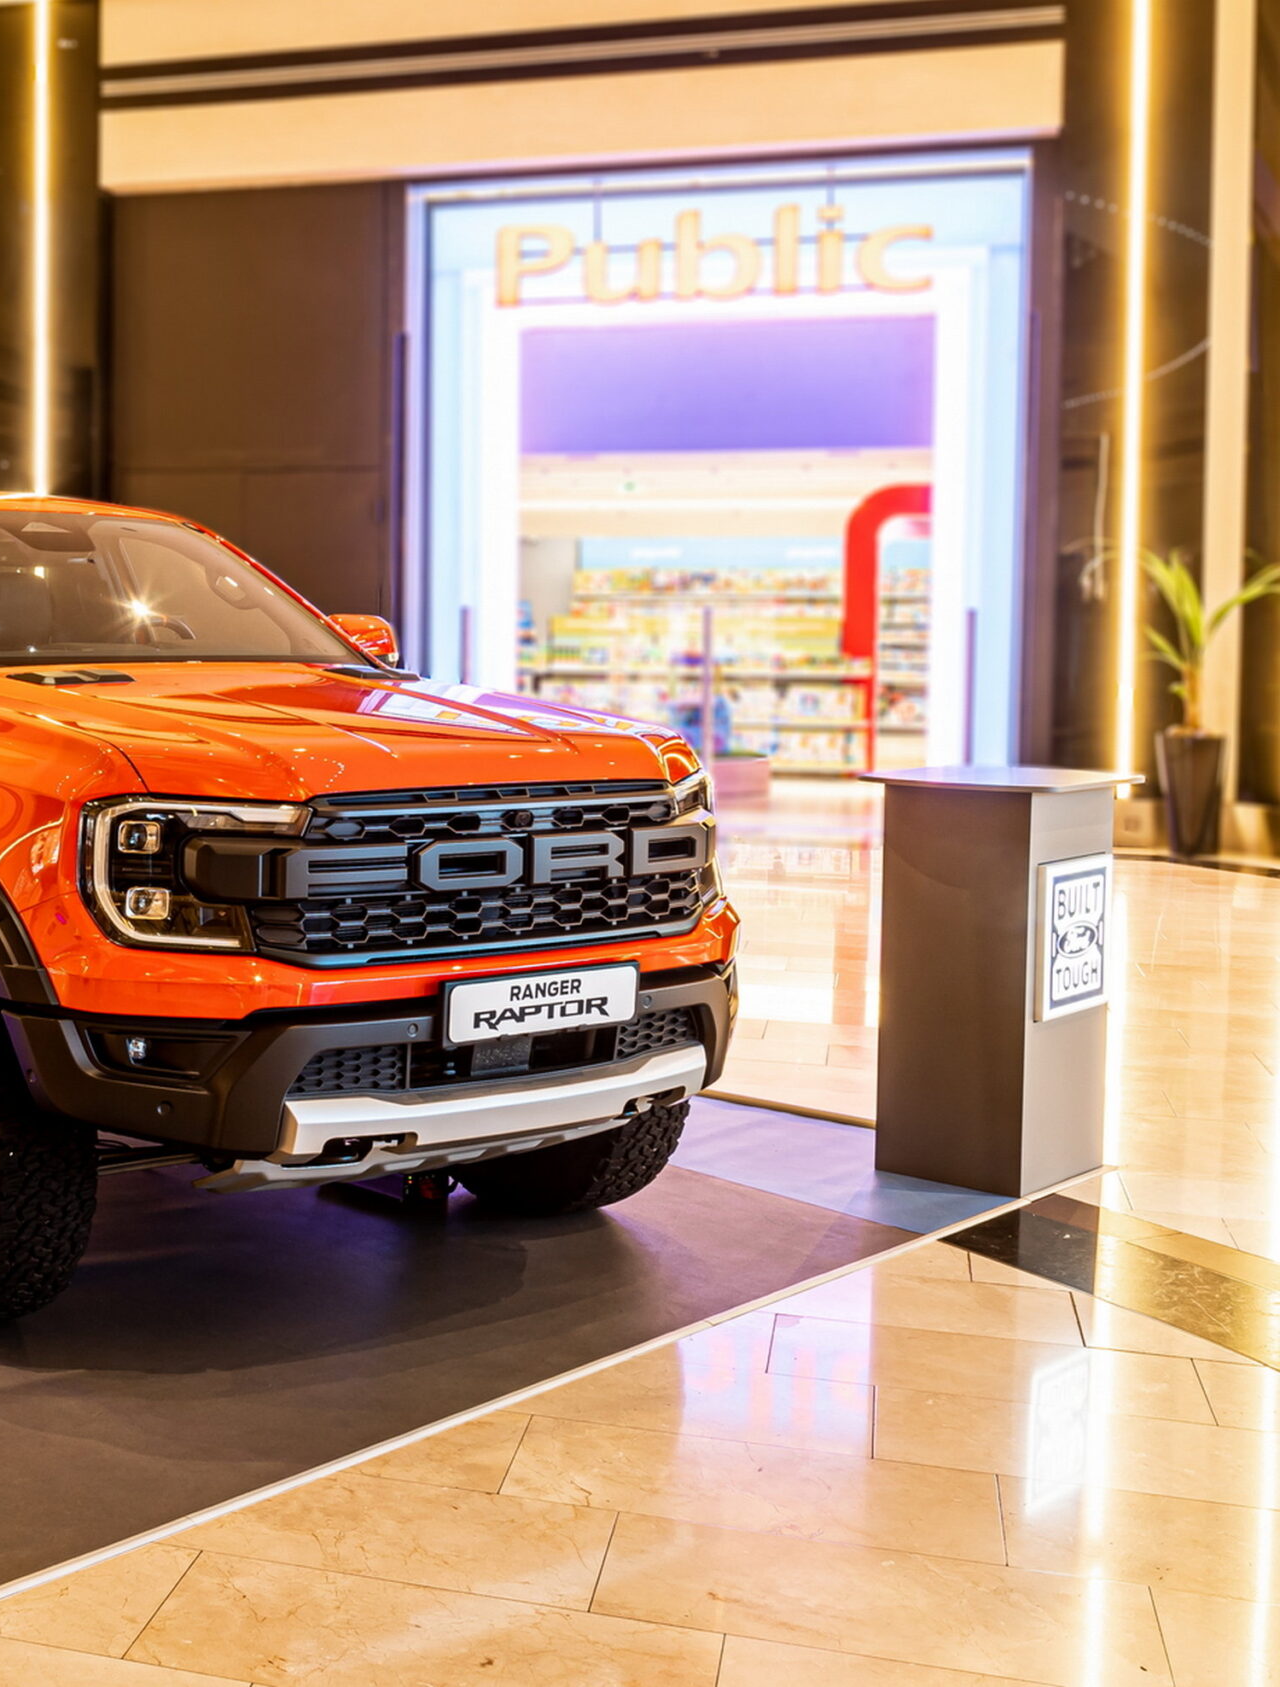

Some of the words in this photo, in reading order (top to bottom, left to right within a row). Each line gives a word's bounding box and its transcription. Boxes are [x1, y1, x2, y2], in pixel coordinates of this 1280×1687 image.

[494, 203, 934, 309] Public
[284, 821, 716, 899] FORD
[1058, 881, 1101, 920] BUILT
[510, 978, 582, 1002] RANGER
[1056, 959, 1099, 993] TOUGH
[473, 996, 610, 1031] RAPTOR
